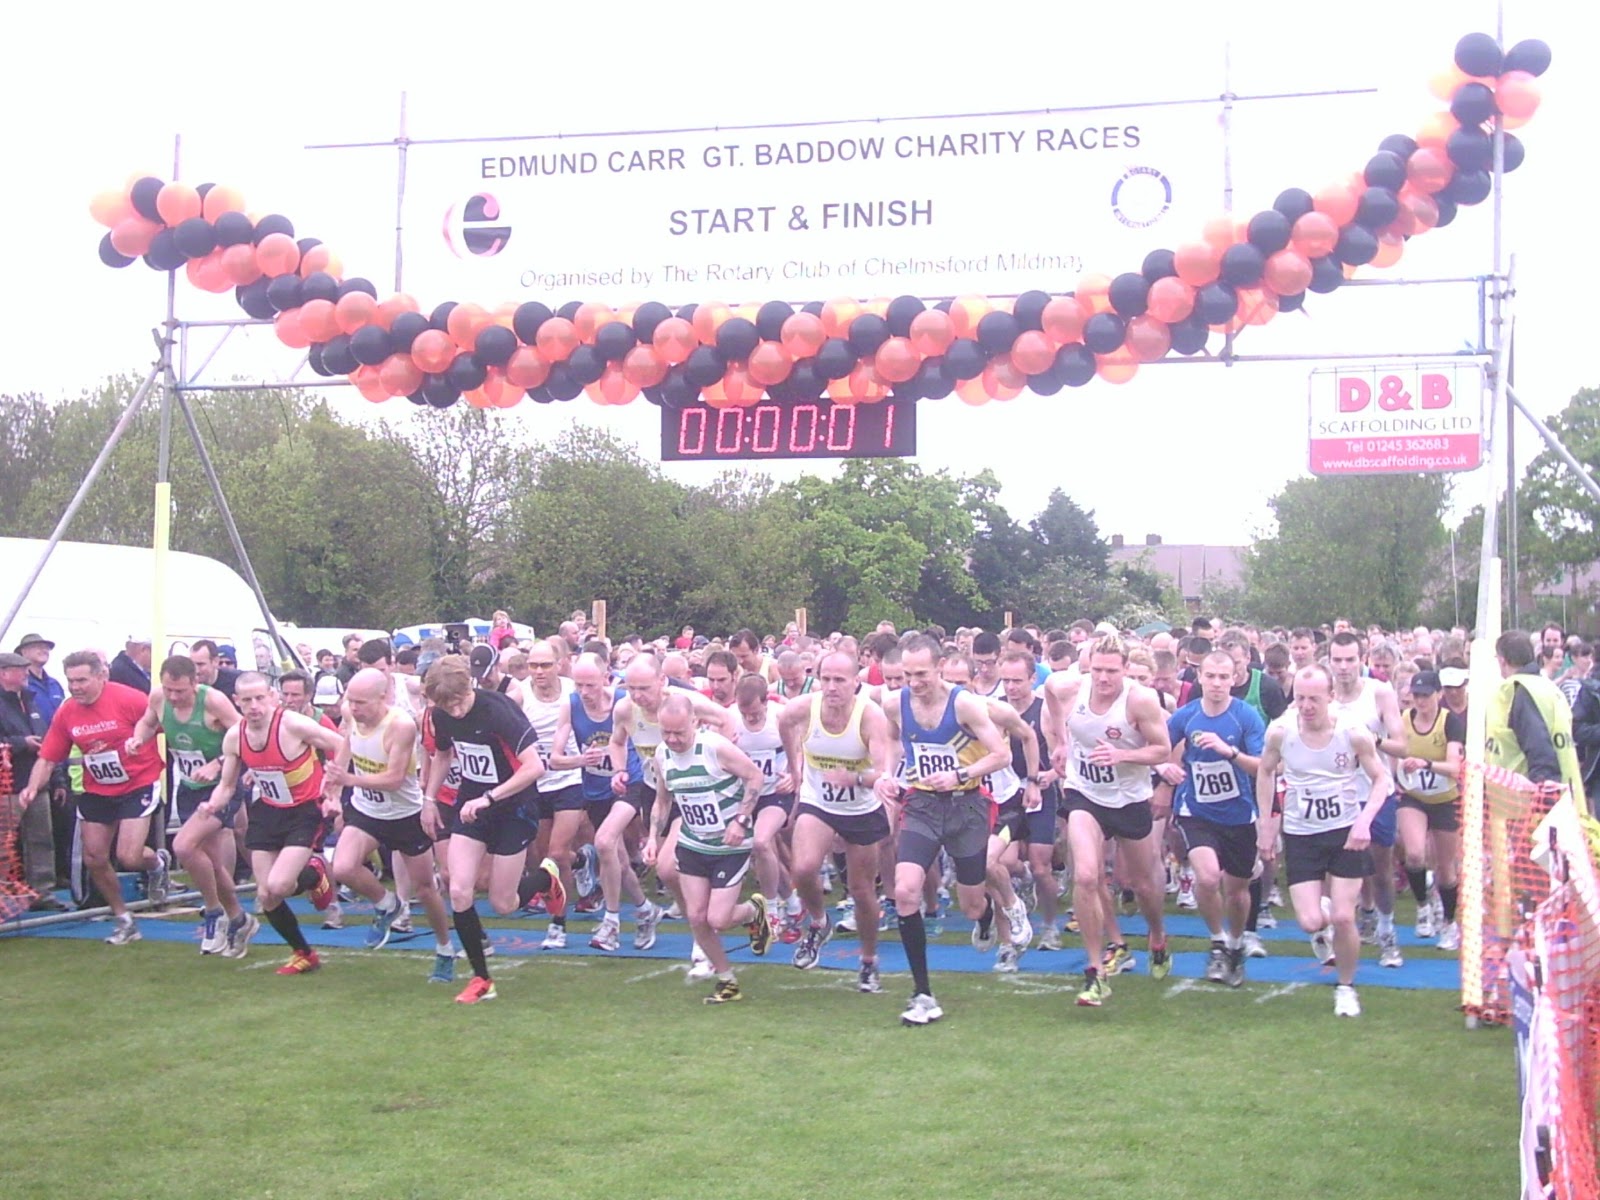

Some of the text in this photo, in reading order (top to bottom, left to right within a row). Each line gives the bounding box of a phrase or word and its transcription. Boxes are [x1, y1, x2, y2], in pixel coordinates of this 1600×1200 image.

[481, 125, 1140, 179] EDMUND CARR GT. BADDOW CHARITY RACES
[669, 199, 932, 236] START & FINISH
[519, 252, 1083, 292] Organised by The Rotary Club of Chelmsford Mildmay
[1339, 374, 1453, 413] D & B
[1319, 416, 1473, 435] SCAFFOLDING LTD
[1345, 437, 1450, 453] Tel 01245 362683
[1322, 454, 1468, 470] www.dbscaffolding.co.uk
[89, 762, 123, 780] 645
[460, 751, 493, 777] 702
[918, 754, 957, 778] 688
[1079, 760, 1115, 784] 403
[260, 780, 280, 799] 81
[821, 781, 856, 803] 321
[1196, 771, 1234, 796] 269
[1418, 769, 1438, 791] 12
[681, 803, 719, 826] 693
[1301, 795, 1341, 821] 785
